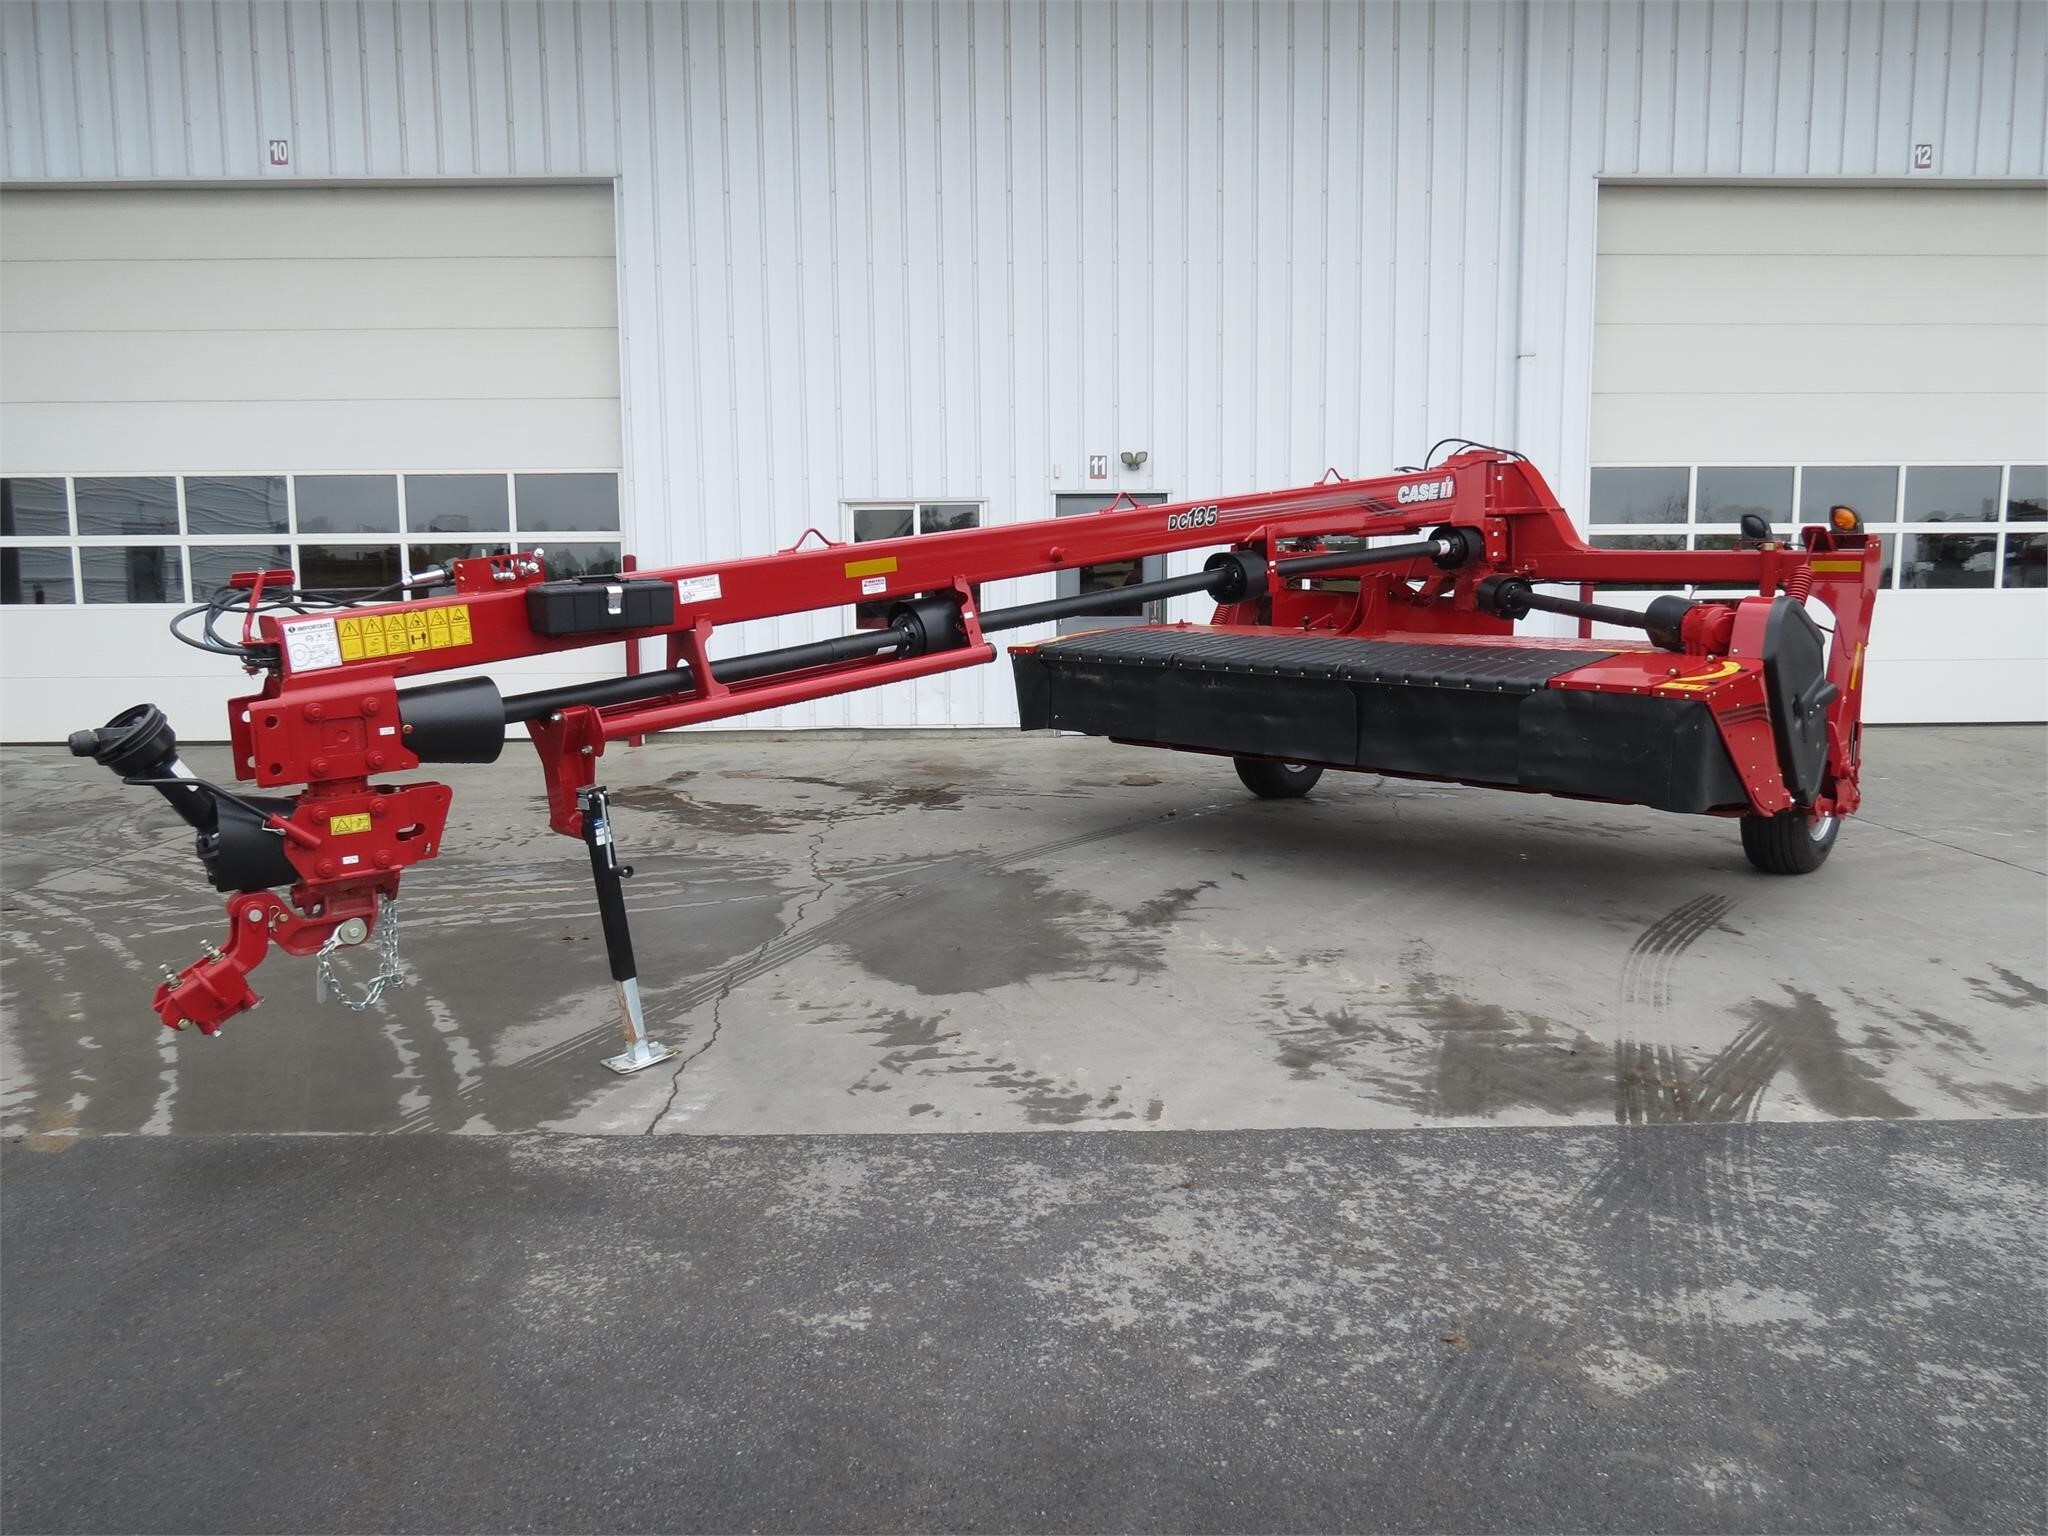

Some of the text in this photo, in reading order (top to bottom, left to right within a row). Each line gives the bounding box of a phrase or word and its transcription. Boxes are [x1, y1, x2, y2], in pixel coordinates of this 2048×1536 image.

[270, 142, 287, 161] 10
[1915, 146, 1931, 164] 12
[1091, 456, 1106, 475] 11
[1398, 482, 1440, 504] CASE
[1168, 505, 1218, 531] DC135
[297, 621, 331, 631] IMPORTANT
